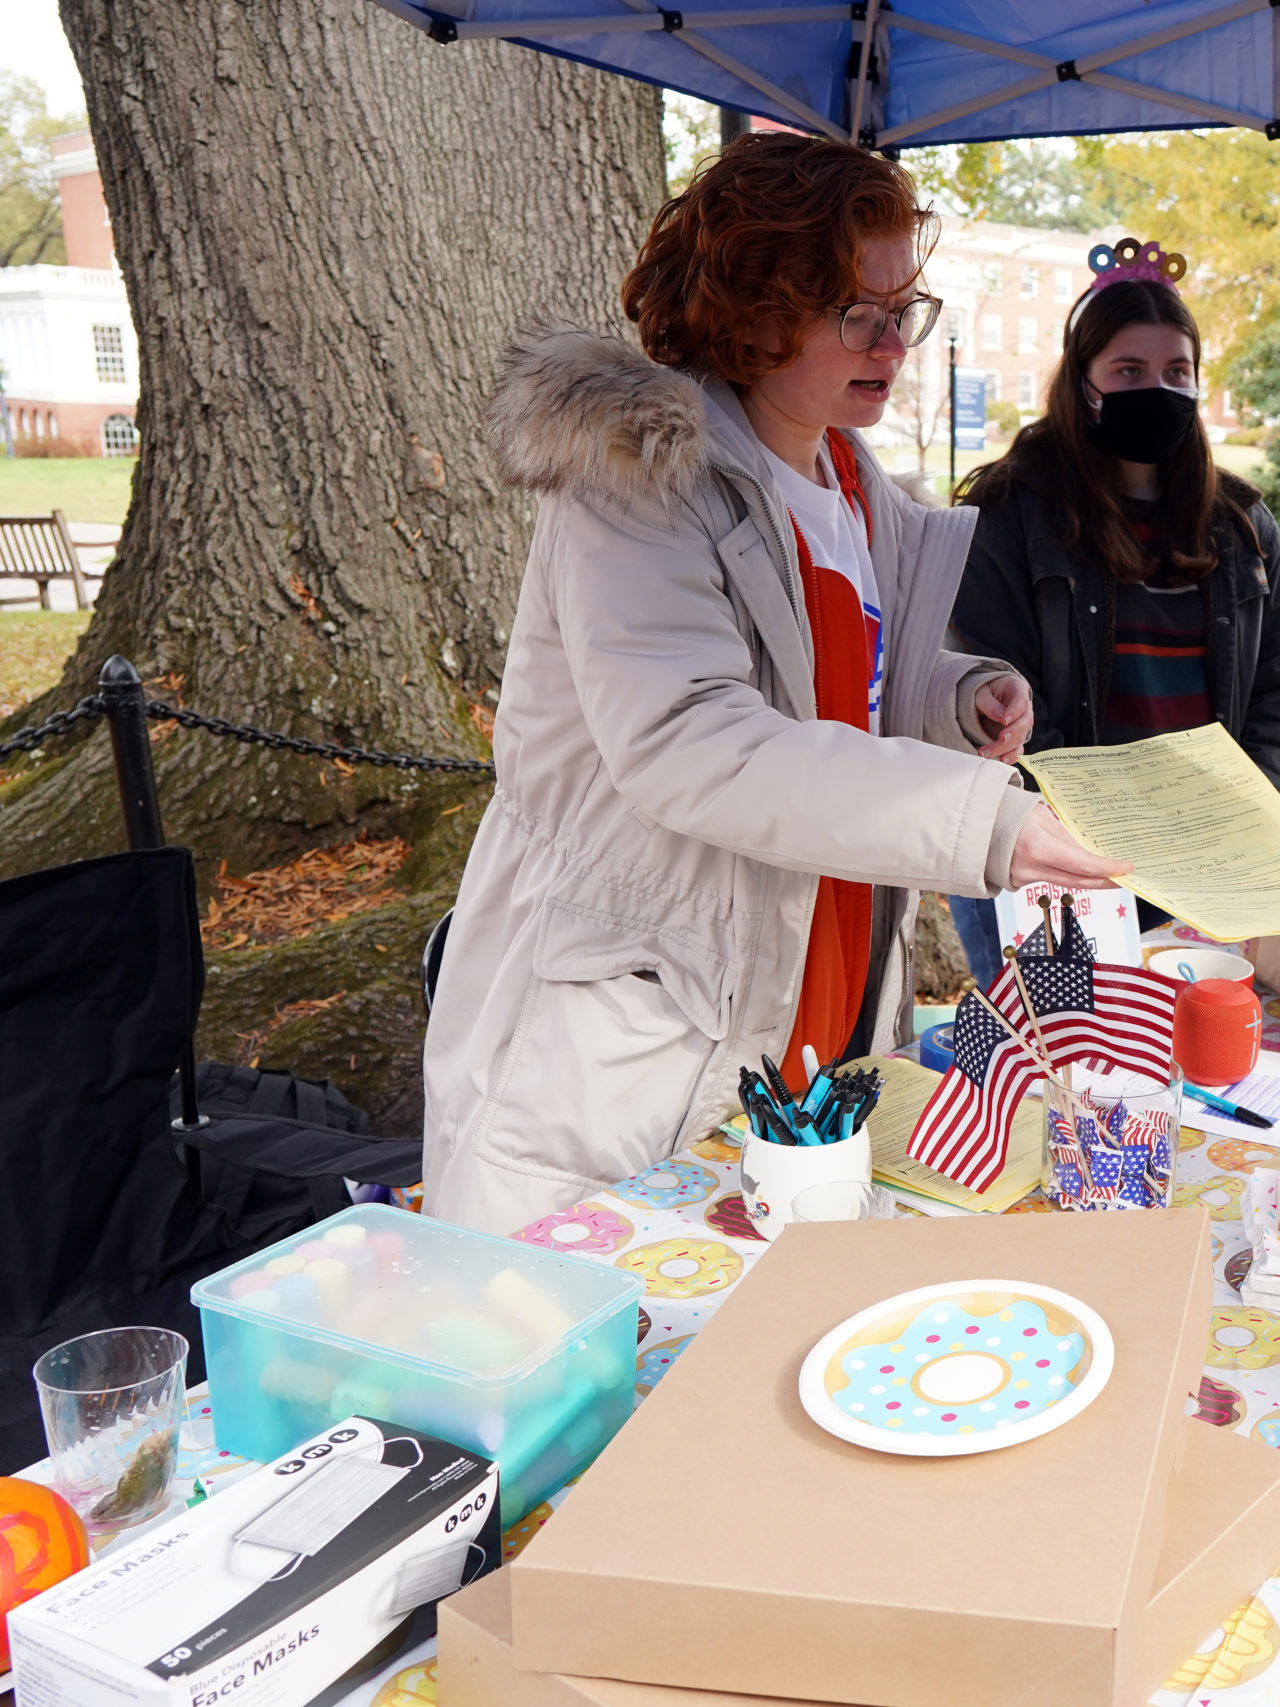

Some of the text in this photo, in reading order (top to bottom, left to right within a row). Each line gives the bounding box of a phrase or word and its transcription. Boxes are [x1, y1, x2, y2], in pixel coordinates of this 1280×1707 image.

[1069, 752, 1100, 761] Registration
[1101, 750, 1132, 759] Application
[45, 1579, 109, 1614] Face
[110, 1531, 190, 1577] Masks
[160, 1626, 228, 1668] 50 pieces
[189, 1675, 218, 1695] Blue
[221, 1631, 288, 1678] Disposable
[191, 1674, 245, 1707] Face
[252, 1623, 320, 1676] Masks
